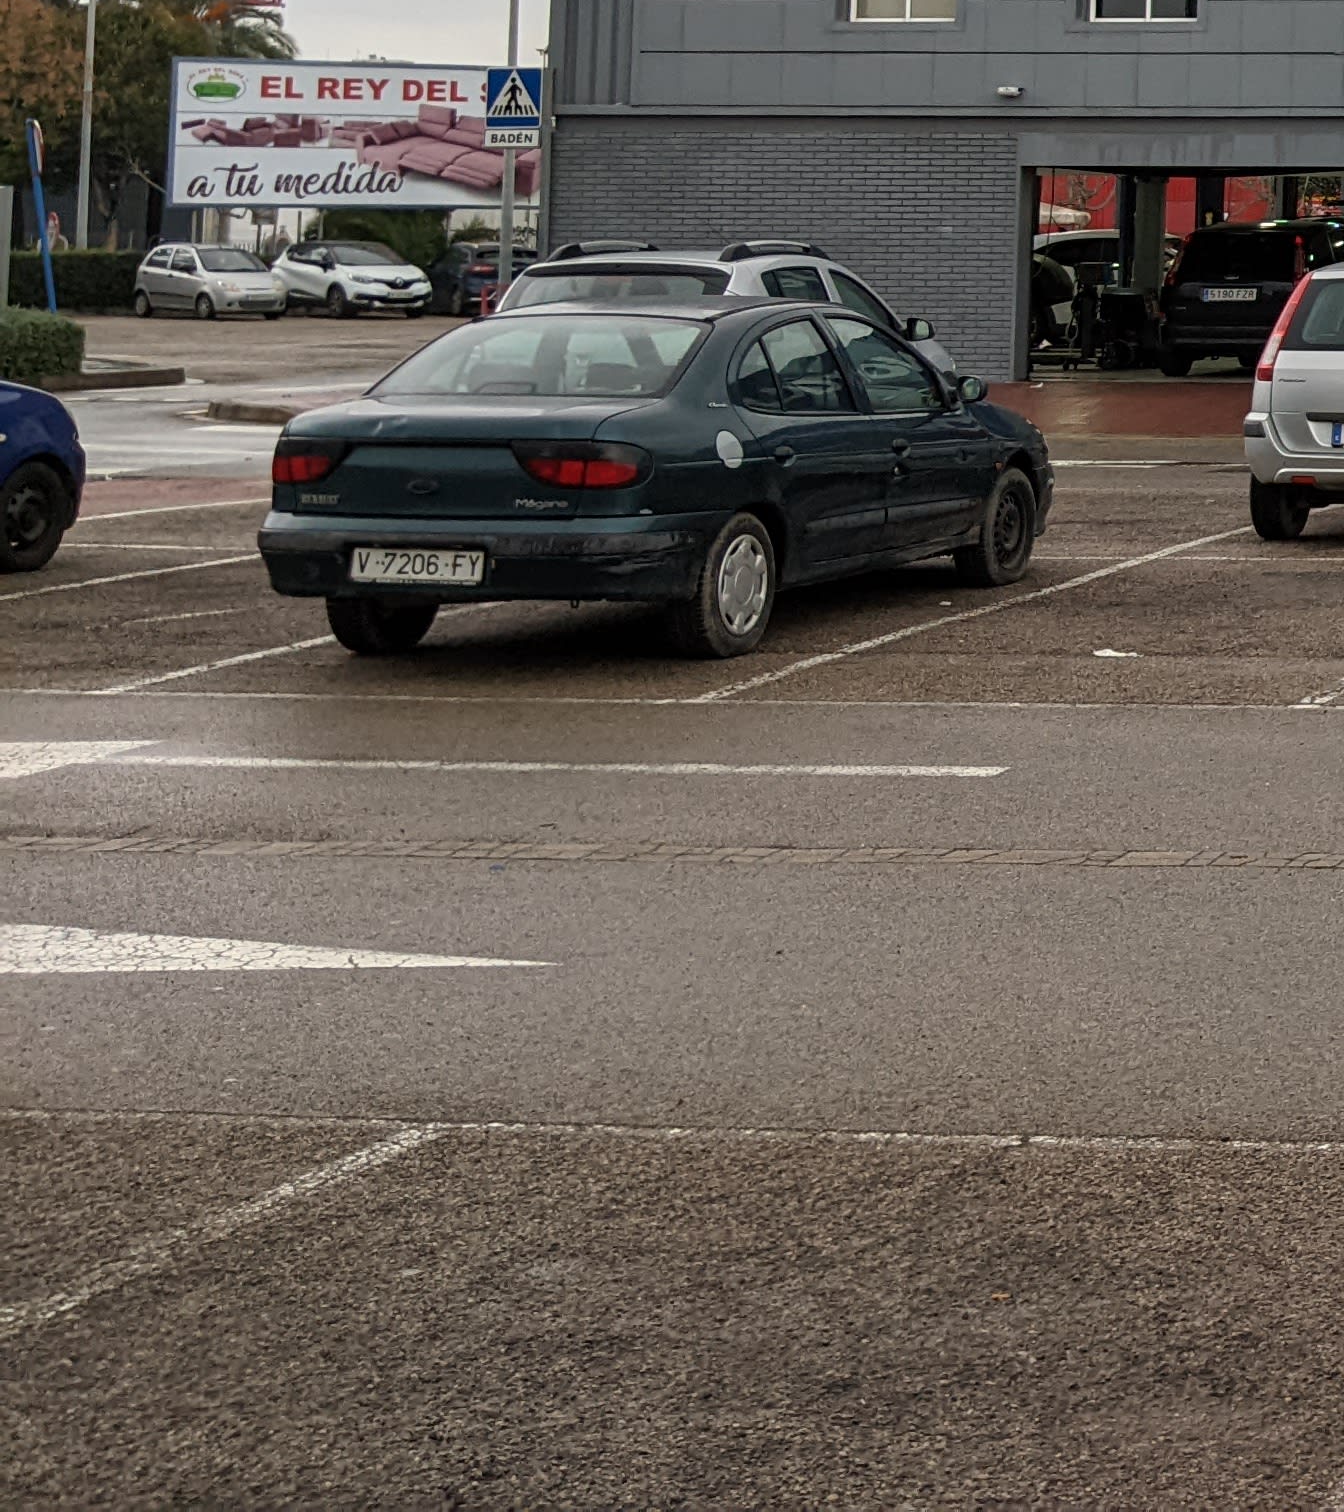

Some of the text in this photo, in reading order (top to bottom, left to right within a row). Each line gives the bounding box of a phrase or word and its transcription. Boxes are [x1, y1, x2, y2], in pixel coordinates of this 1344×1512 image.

[260, 76, 303, 99] EL
[317, 77, 390, 101] REY
[403, 79, 468, 103] DEL
[490, 131, 533, 144] BADÉN
[186, 160, 404, 199] a tu medida
[358, 551, 480, 577] V 7206 FY
